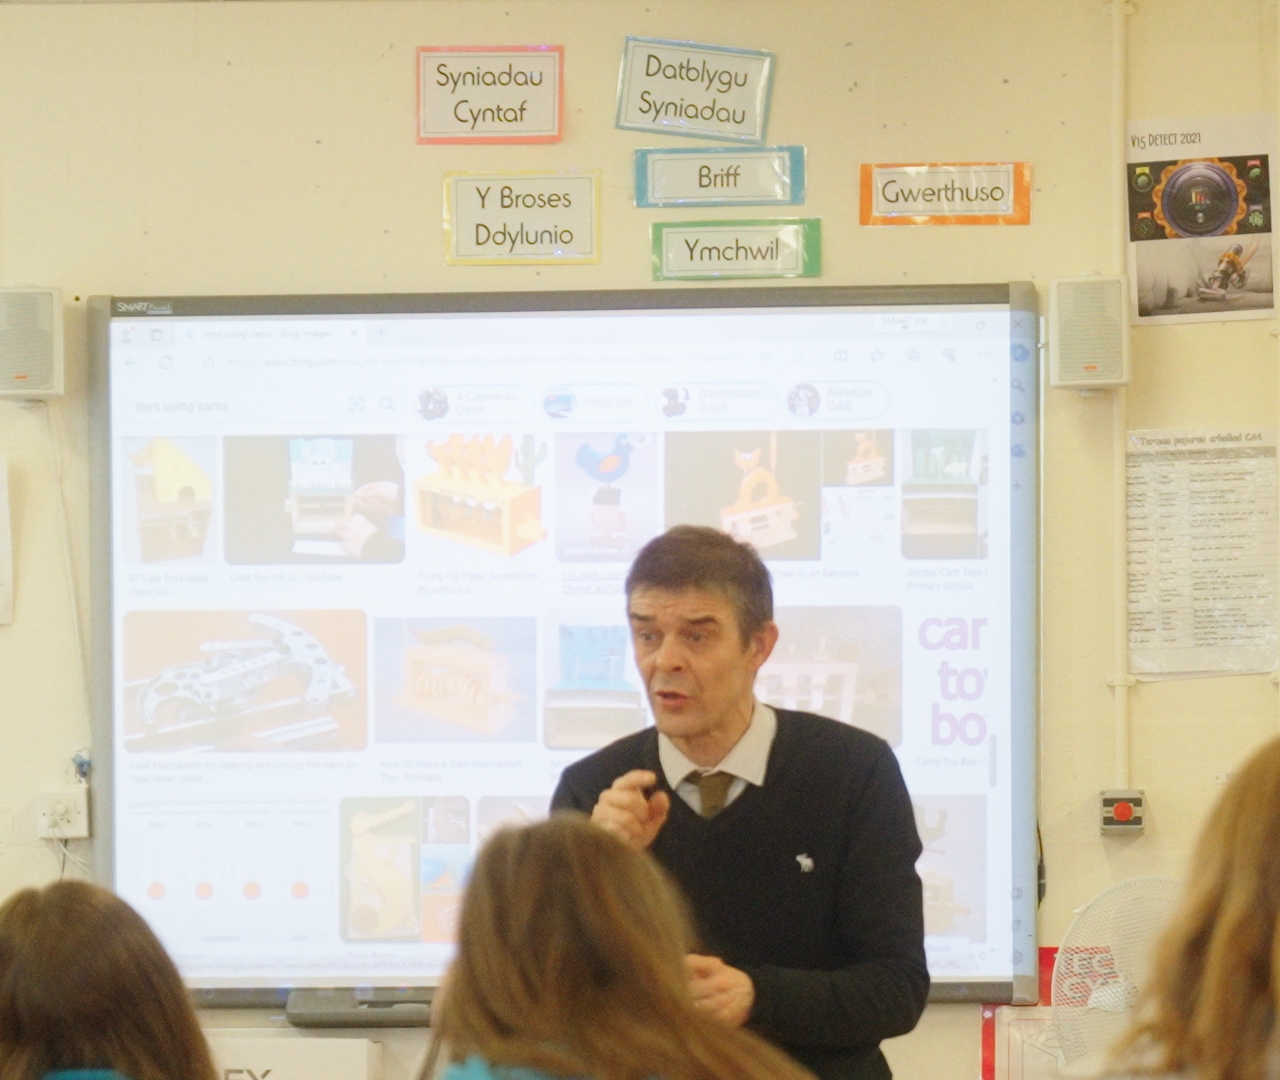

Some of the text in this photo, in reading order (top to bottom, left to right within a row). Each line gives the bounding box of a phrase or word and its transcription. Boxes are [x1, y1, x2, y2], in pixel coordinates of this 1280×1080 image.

[436, 63, 543, 94] Syniadau
[645, 54, 748, 93] Datblygu
[454, 100, 527, 130] Cyntaf
[638, 90, 746, 124] Syniadau
[1130, 132, 1201, 150] V15 DETECT 2021
[698, 165, 741, 188] Briff
[475, 186, 572, 209] Y Broses
[882, 179, 1005, 203] Gwerthuso
[475, 223, 574, 253] Ddylunio
[684, 238, 779, 261] Ymchwil
[117, 302, 150, 312] SMART
[583, 397, 633, 411] Program
[699, 388, 762, 399] Dashboard
[828, 388, 872, 398] Newton
[136, 402, 229, 414] toys using cams
[699, 402, 729, 413] Dash
[937, 661, 988, 701] to
[931, 702, 988, 746] bo
